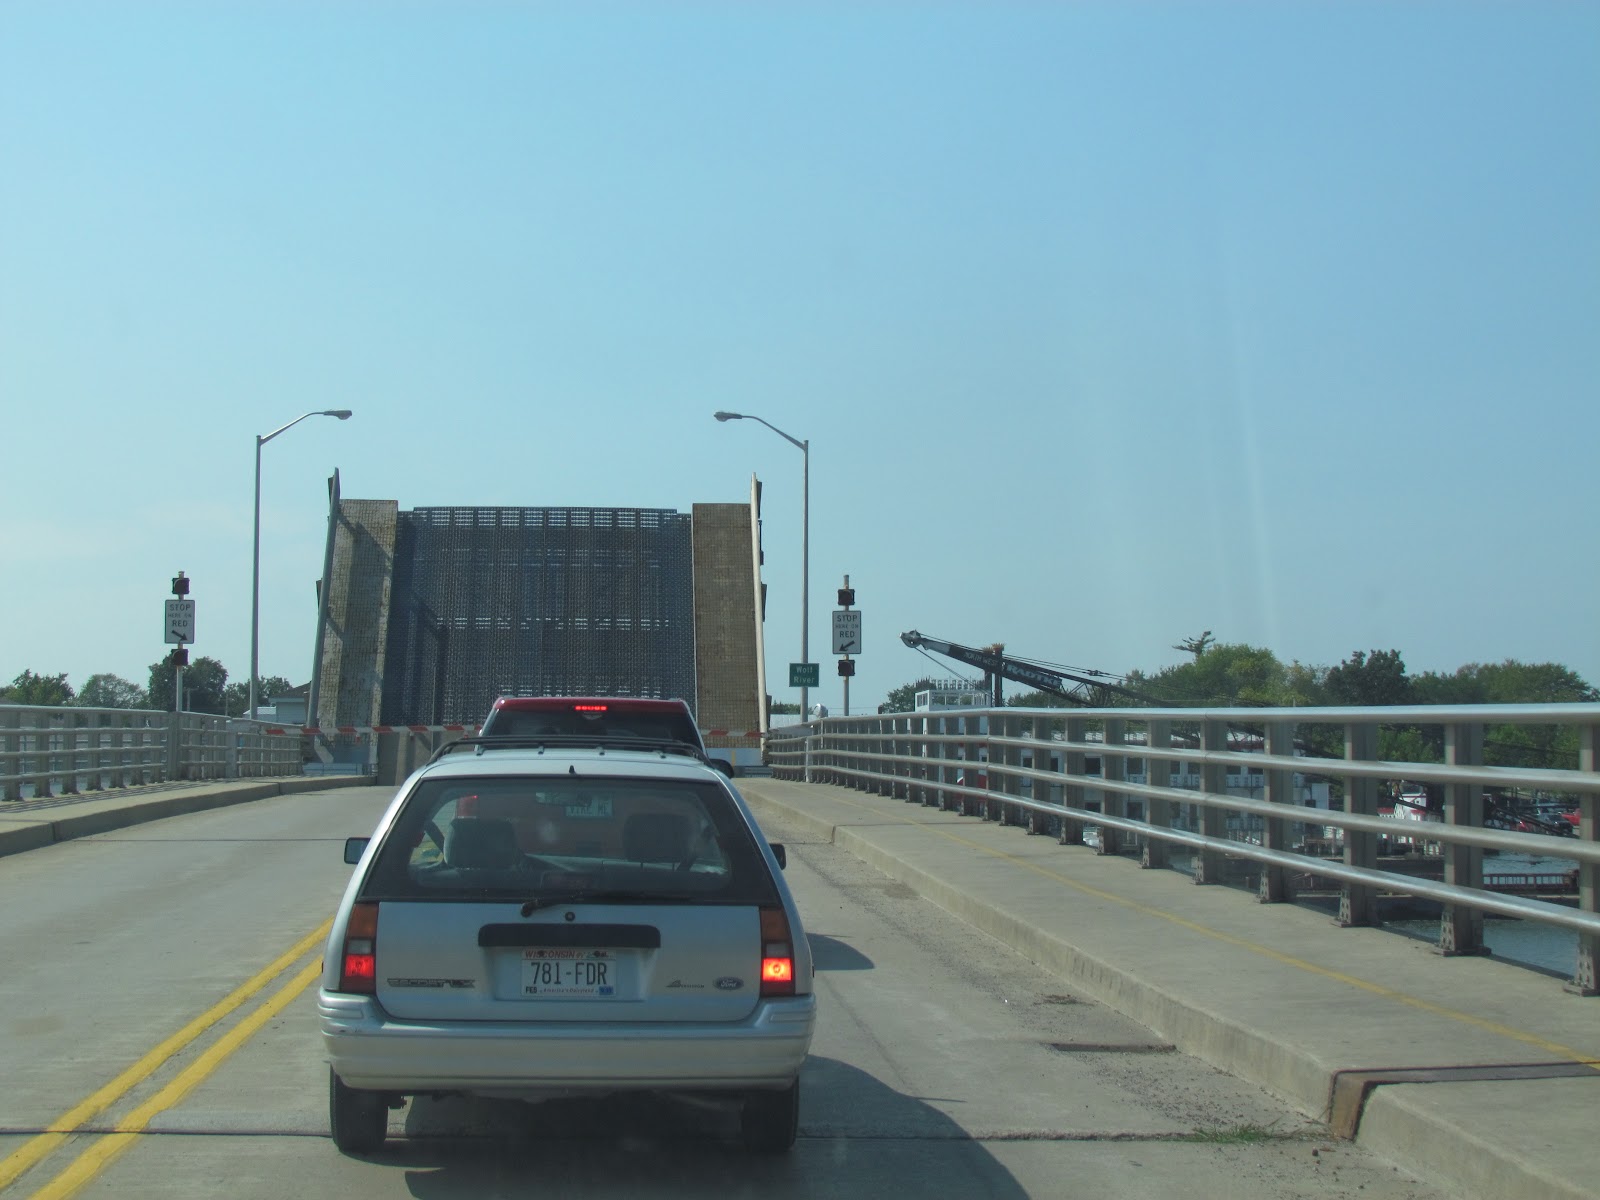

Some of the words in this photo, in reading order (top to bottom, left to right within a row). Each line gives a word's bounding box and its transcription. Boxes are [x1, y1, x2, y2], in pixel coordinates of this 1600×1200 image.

[170, 603, 191, 611] STOP
[837, 614, 858, 622] STOP
[839, 630, 855, 638] RED
[793, 676, 815, 684] River
[525, 950, 575, 959] WISCONSIN
[531, 962, 607, 985] 781-FDR
